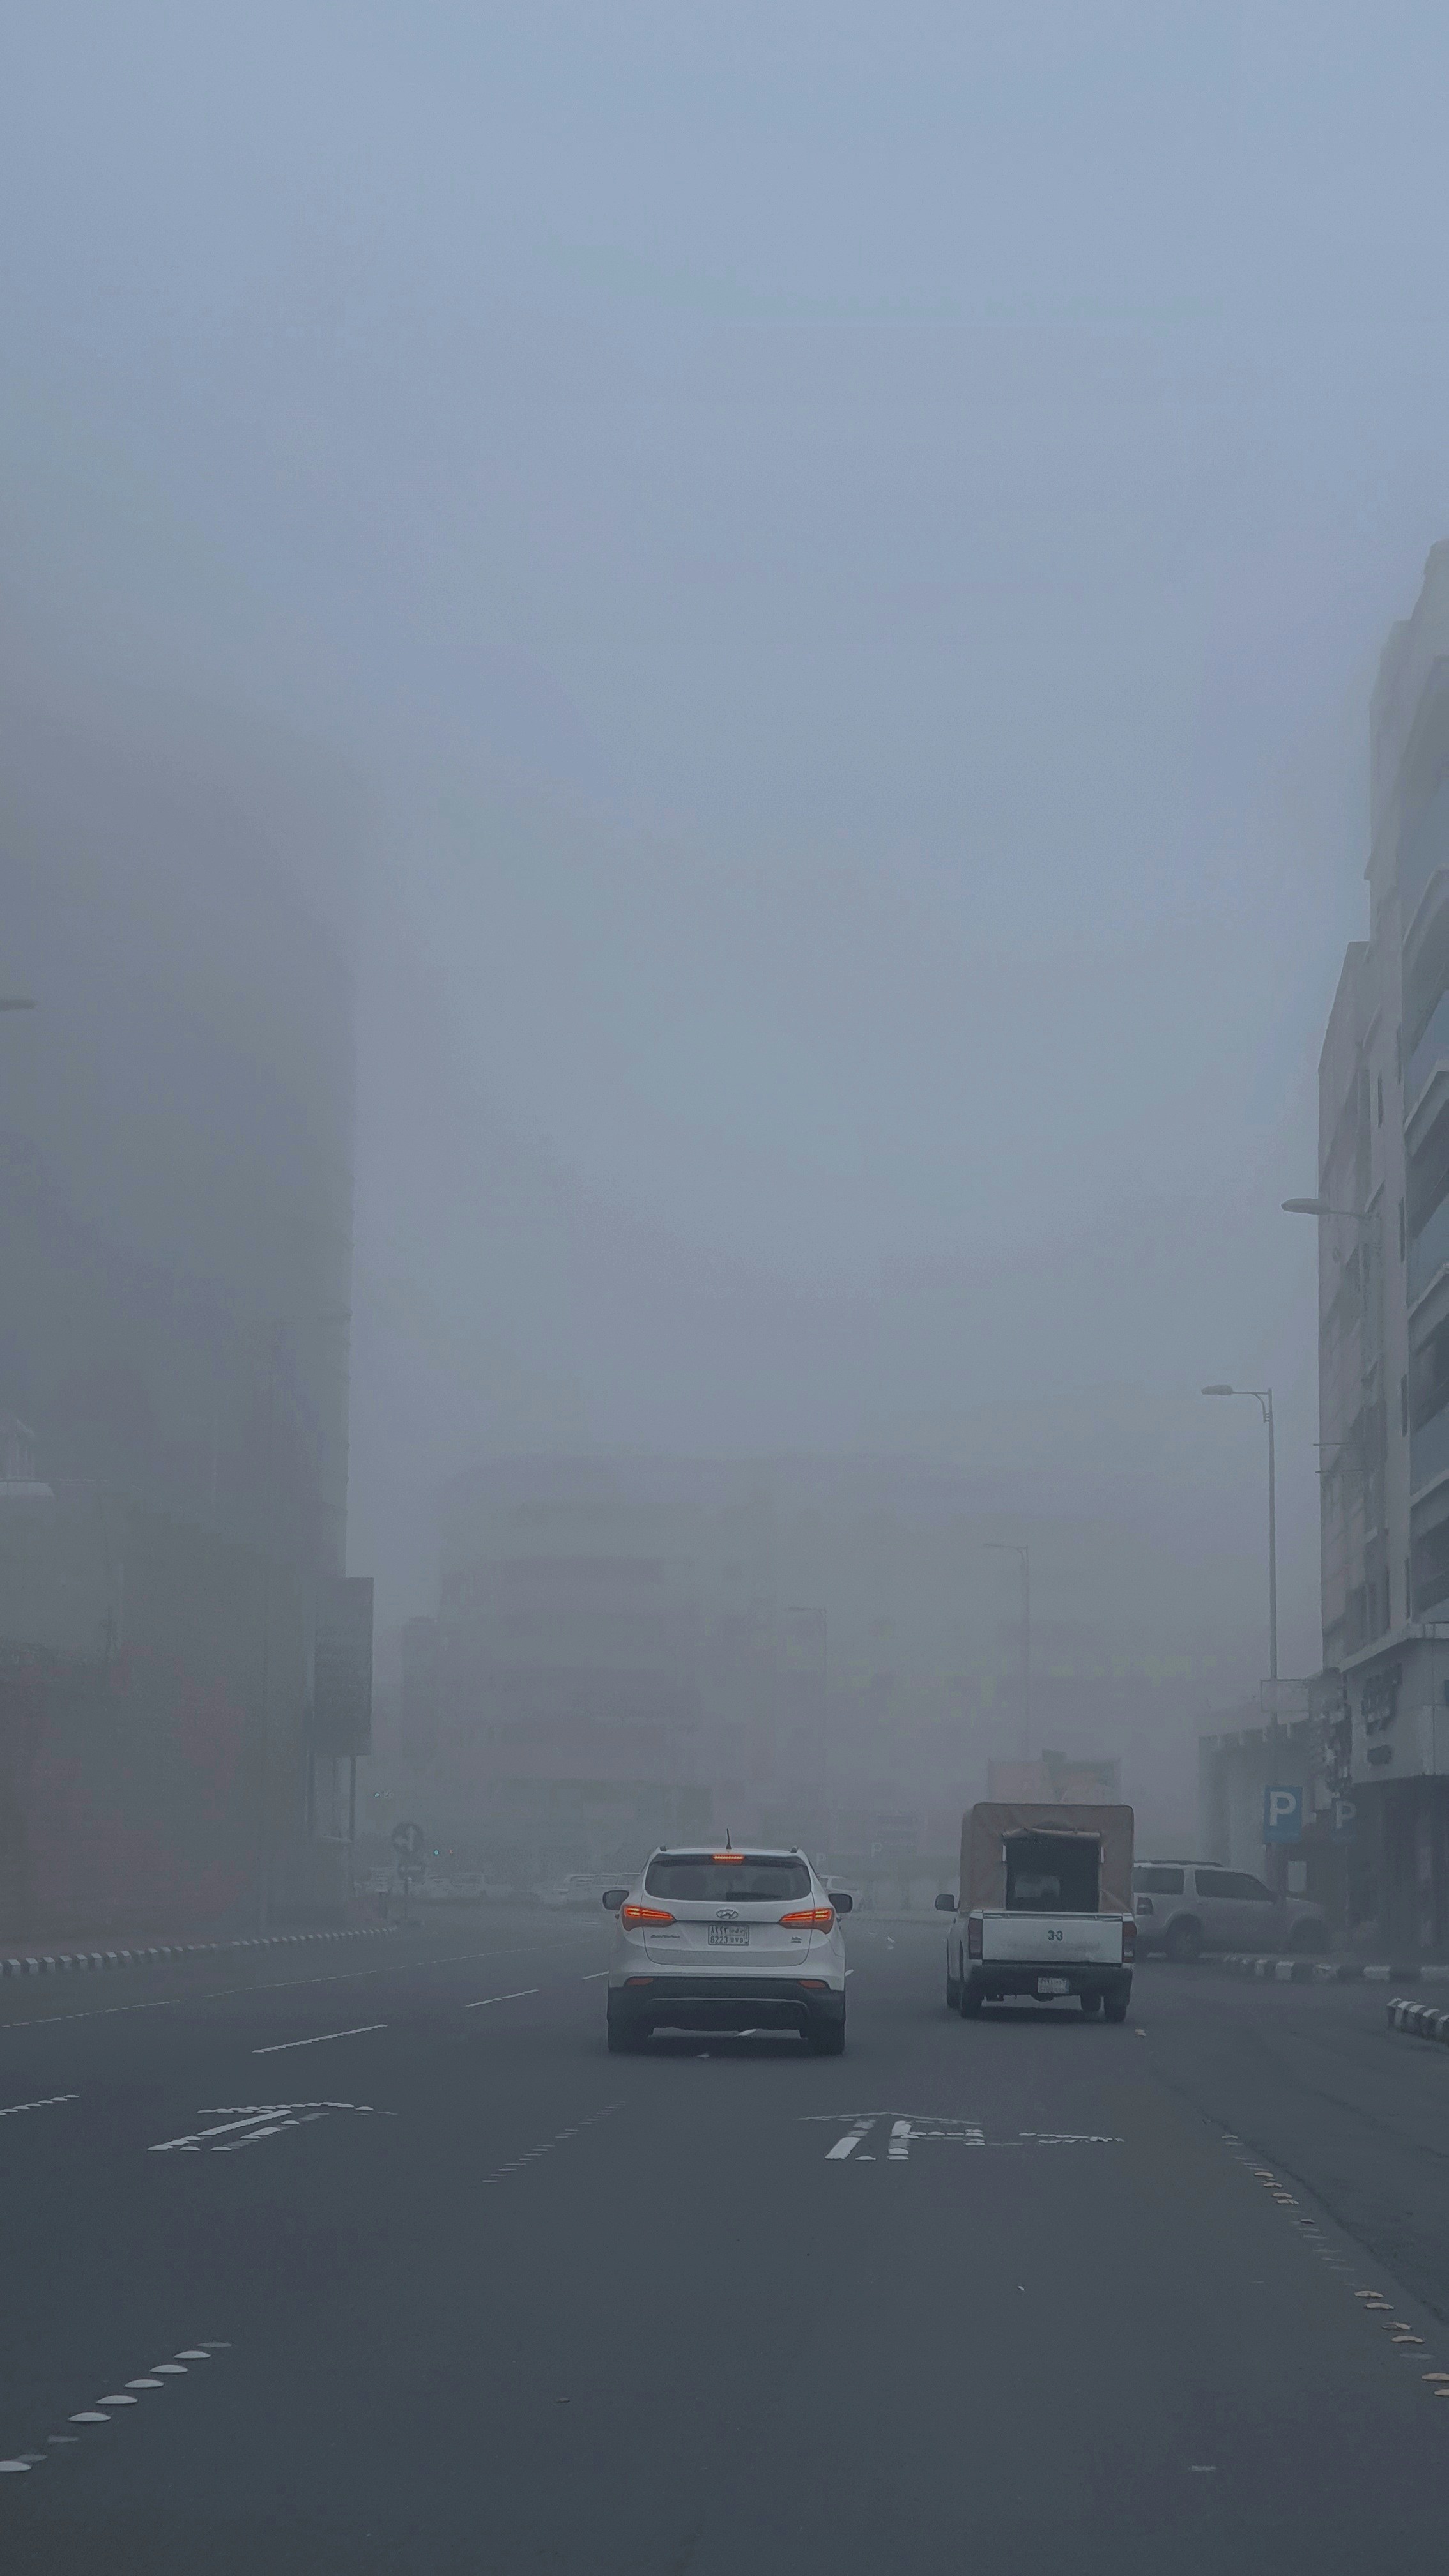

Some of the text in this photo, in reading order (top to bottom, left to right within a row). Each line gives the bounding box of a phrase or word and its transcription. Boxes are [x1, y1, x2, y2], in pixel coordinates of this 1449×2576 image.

[1269, 1791, 1296, 1826] P
[1336, 1800, 1356, 1829] P
[870, 1842, 883, 1857] P
[710, 1936, 728, 1944] 8223
